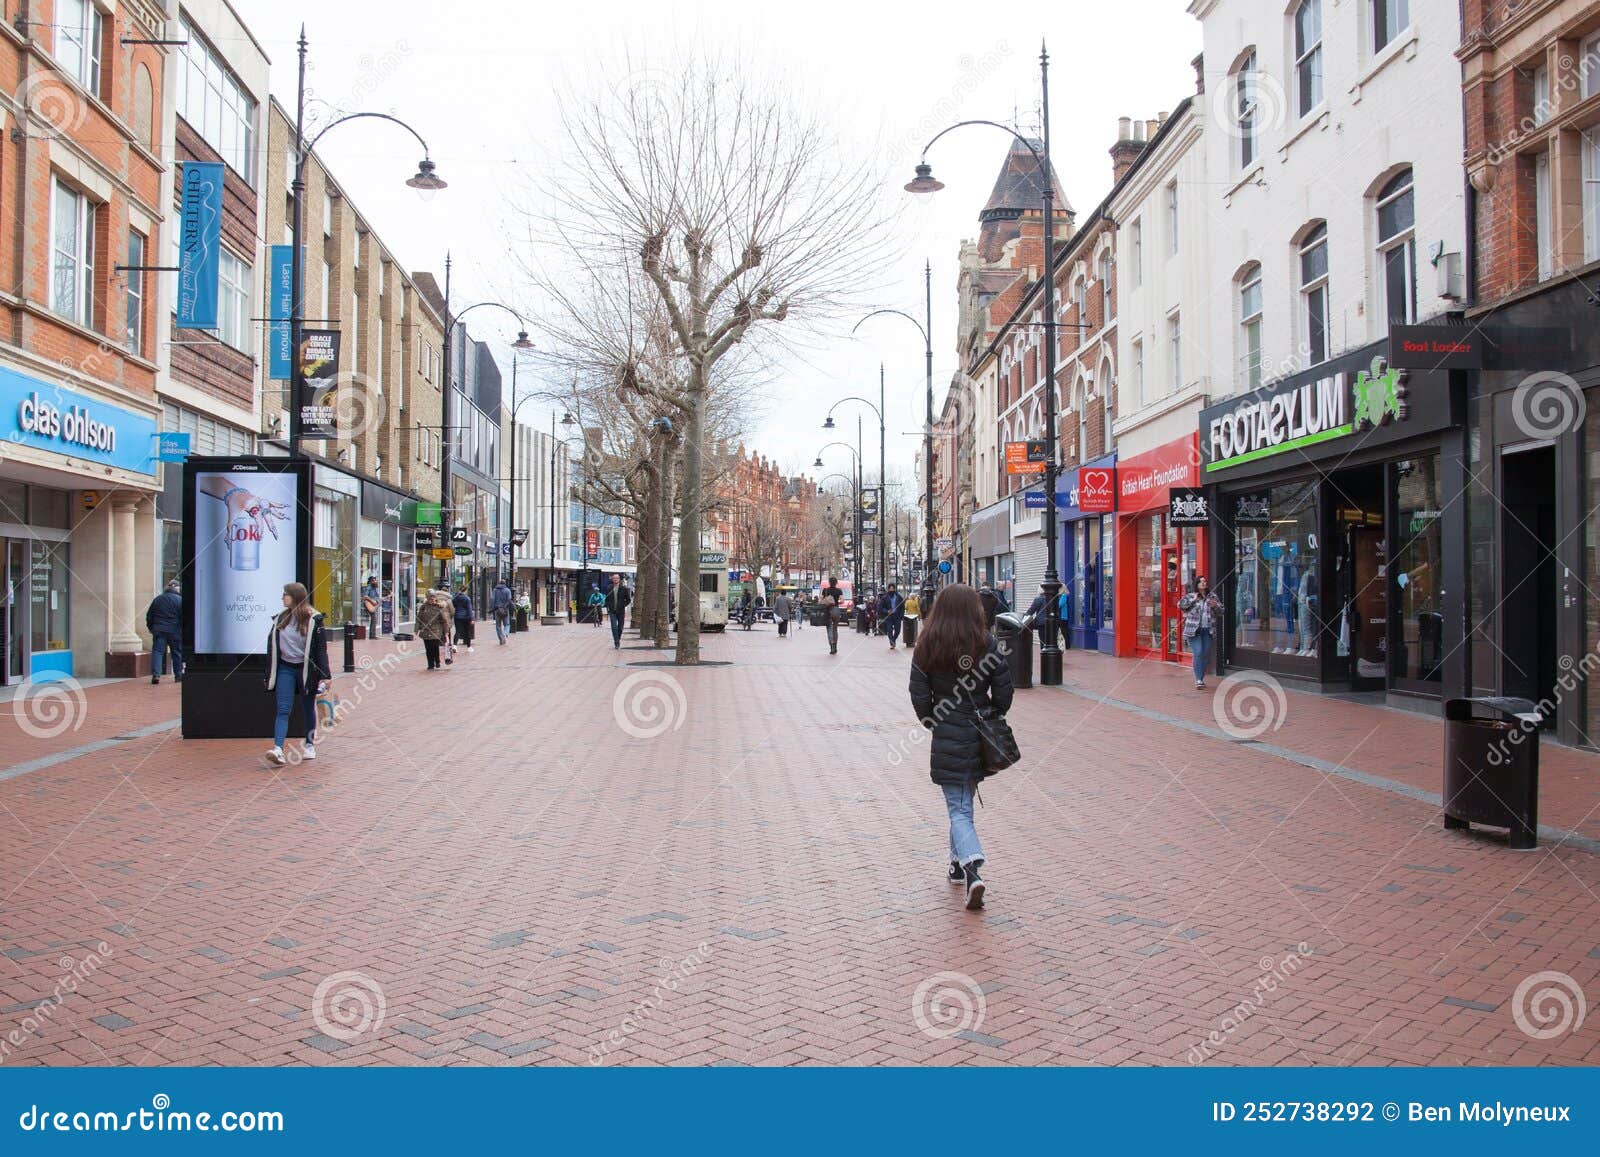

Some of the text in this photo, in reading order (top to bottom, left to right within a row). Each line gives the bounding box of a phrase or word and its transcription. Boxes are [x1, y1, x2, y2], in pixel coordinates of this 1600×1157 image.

[185, 168, 200, 253] CHILTERN
[182, 252, 194, 319] medical clinic
[280, 263, 292, 290] Laser
[280, 293, 291, 315] Hair
[1403, 340, 1471, 352] Foot Locker
[18, 391, 116, 453] clas ohlson
[1210, 372, 1346, 462] FOOTASYLUM
[1122, 463, 1188, 497] British Heart Foundation
[454, 530, 466, 539] JD
[702, 553, 726, 562] WRAPS
[226, 603, 266, 614] what you
[236, 593, 254, 602] love
[236, 613, 255, 622] love
